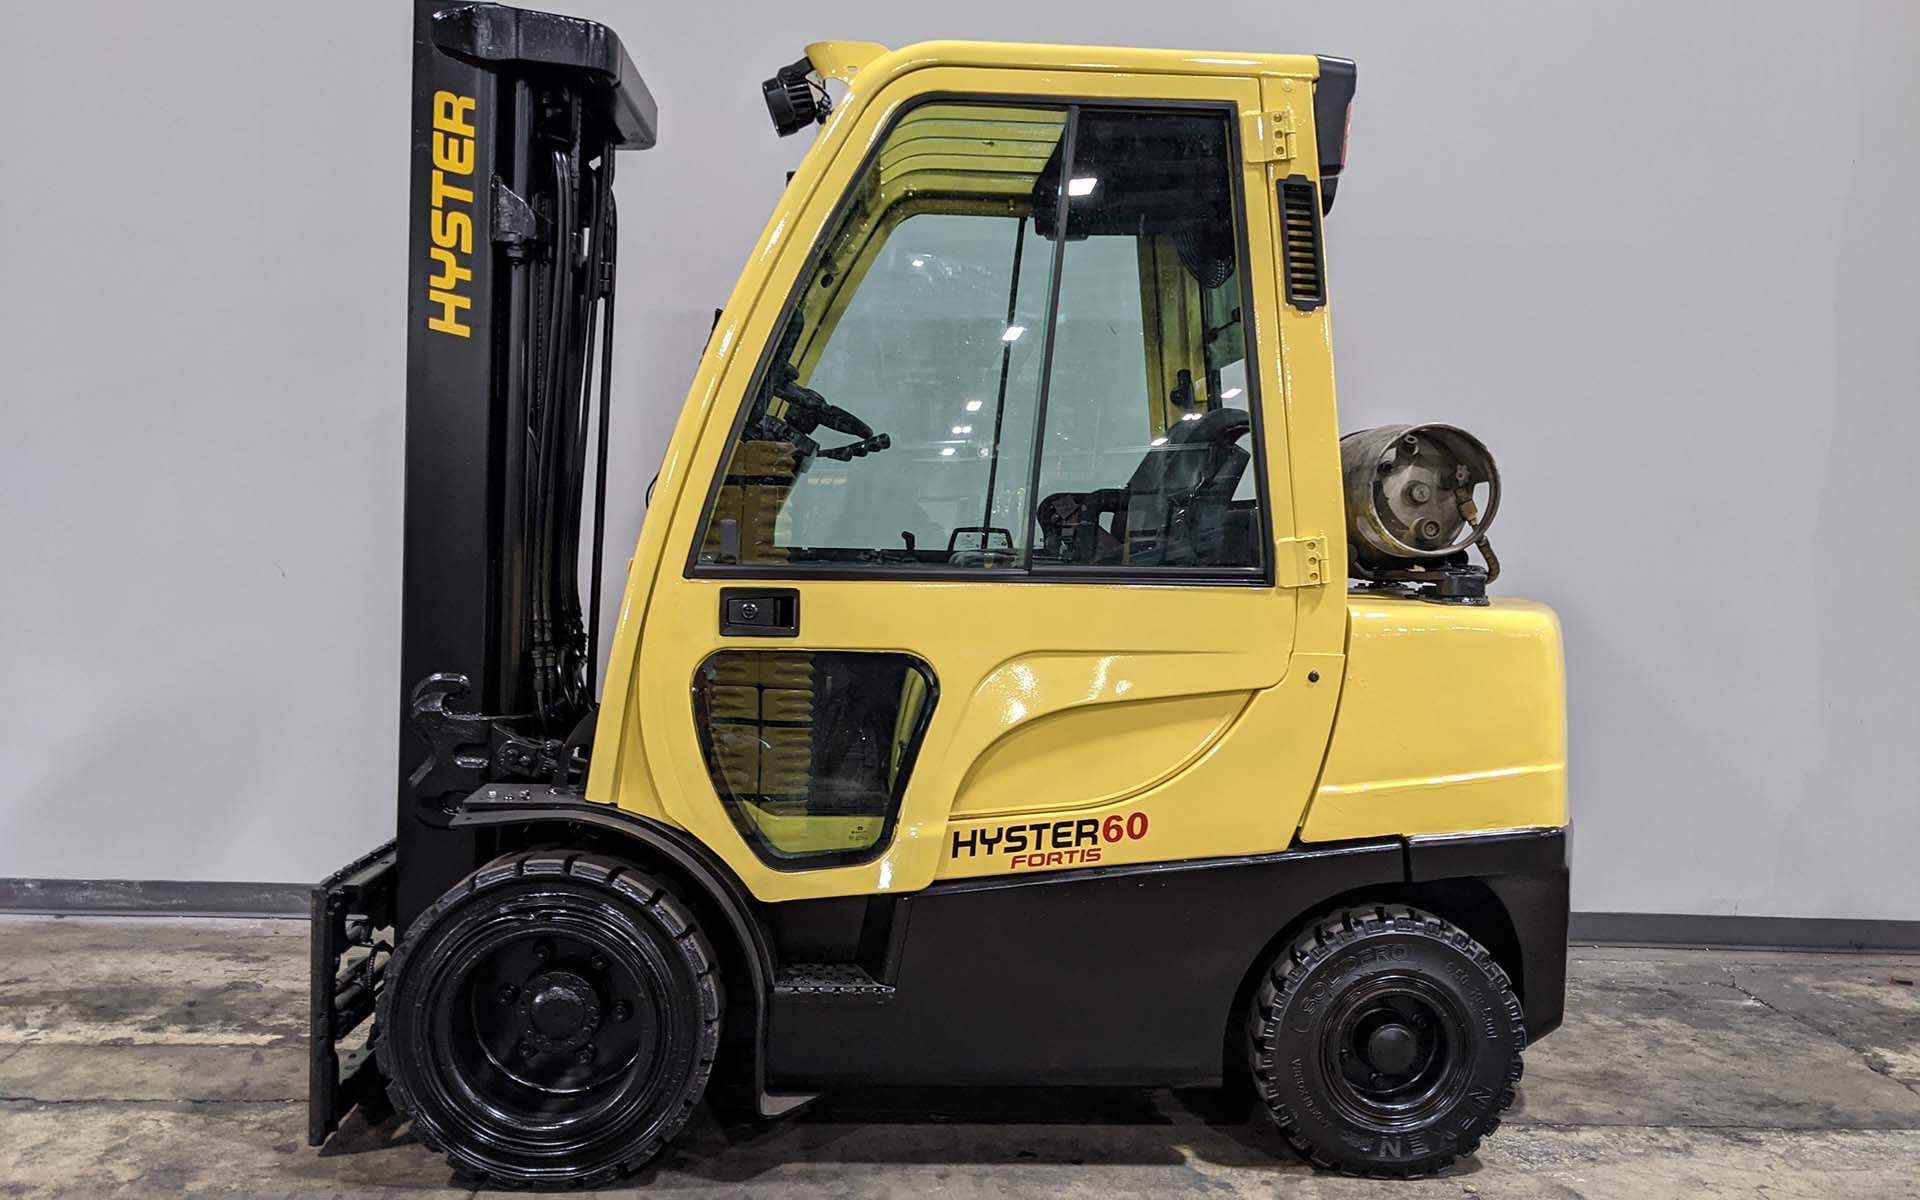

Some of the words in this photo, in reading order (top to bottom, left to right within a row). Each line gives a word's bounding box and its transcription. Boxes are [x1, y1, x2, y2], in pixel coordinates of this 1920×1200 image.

[428, 89, 476, 338] HYSTER
[951, 818, 1099, 859] HYSTER
[1102, 811, 1149, 843] 60
[1010, 847, 1101, 869] FORTIS
